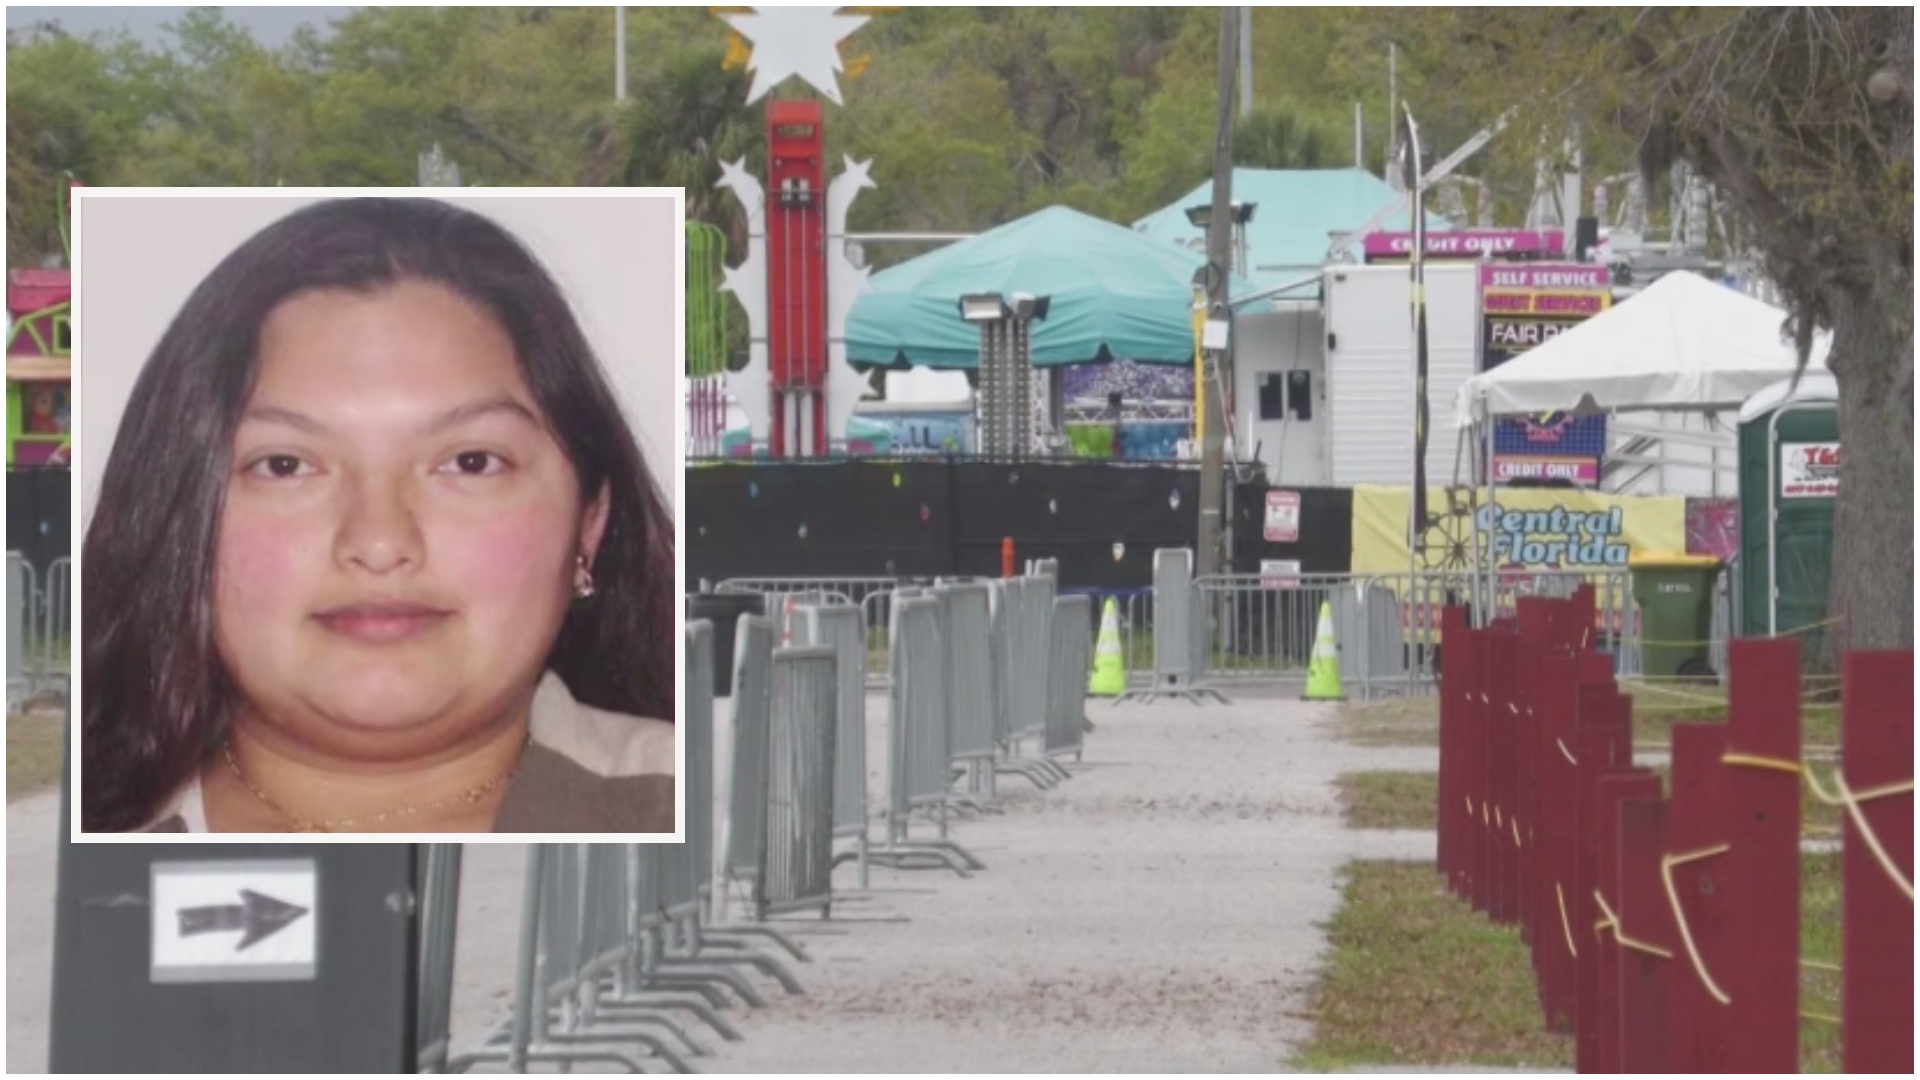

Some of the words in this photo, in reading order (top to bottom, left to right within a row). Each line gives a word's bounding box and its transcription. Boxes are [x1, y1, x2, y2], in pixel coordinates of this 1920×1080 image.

[1390, 236, 1459, 251] CRDIT
[1464, 236, 1515, 251] ONLY
[1492, 271, 1527, 286] SELF
[1532, 271, 1598, 287] SERVICE
[1491, 322, 1539, 343] FAIR
[1499, 462, 1542, 478] CREDIT
[1545, 462, 1580, 478] ONLY
[1477, 502, 1623, 536] Central
[1486, 530, 1630, 565] Florida
